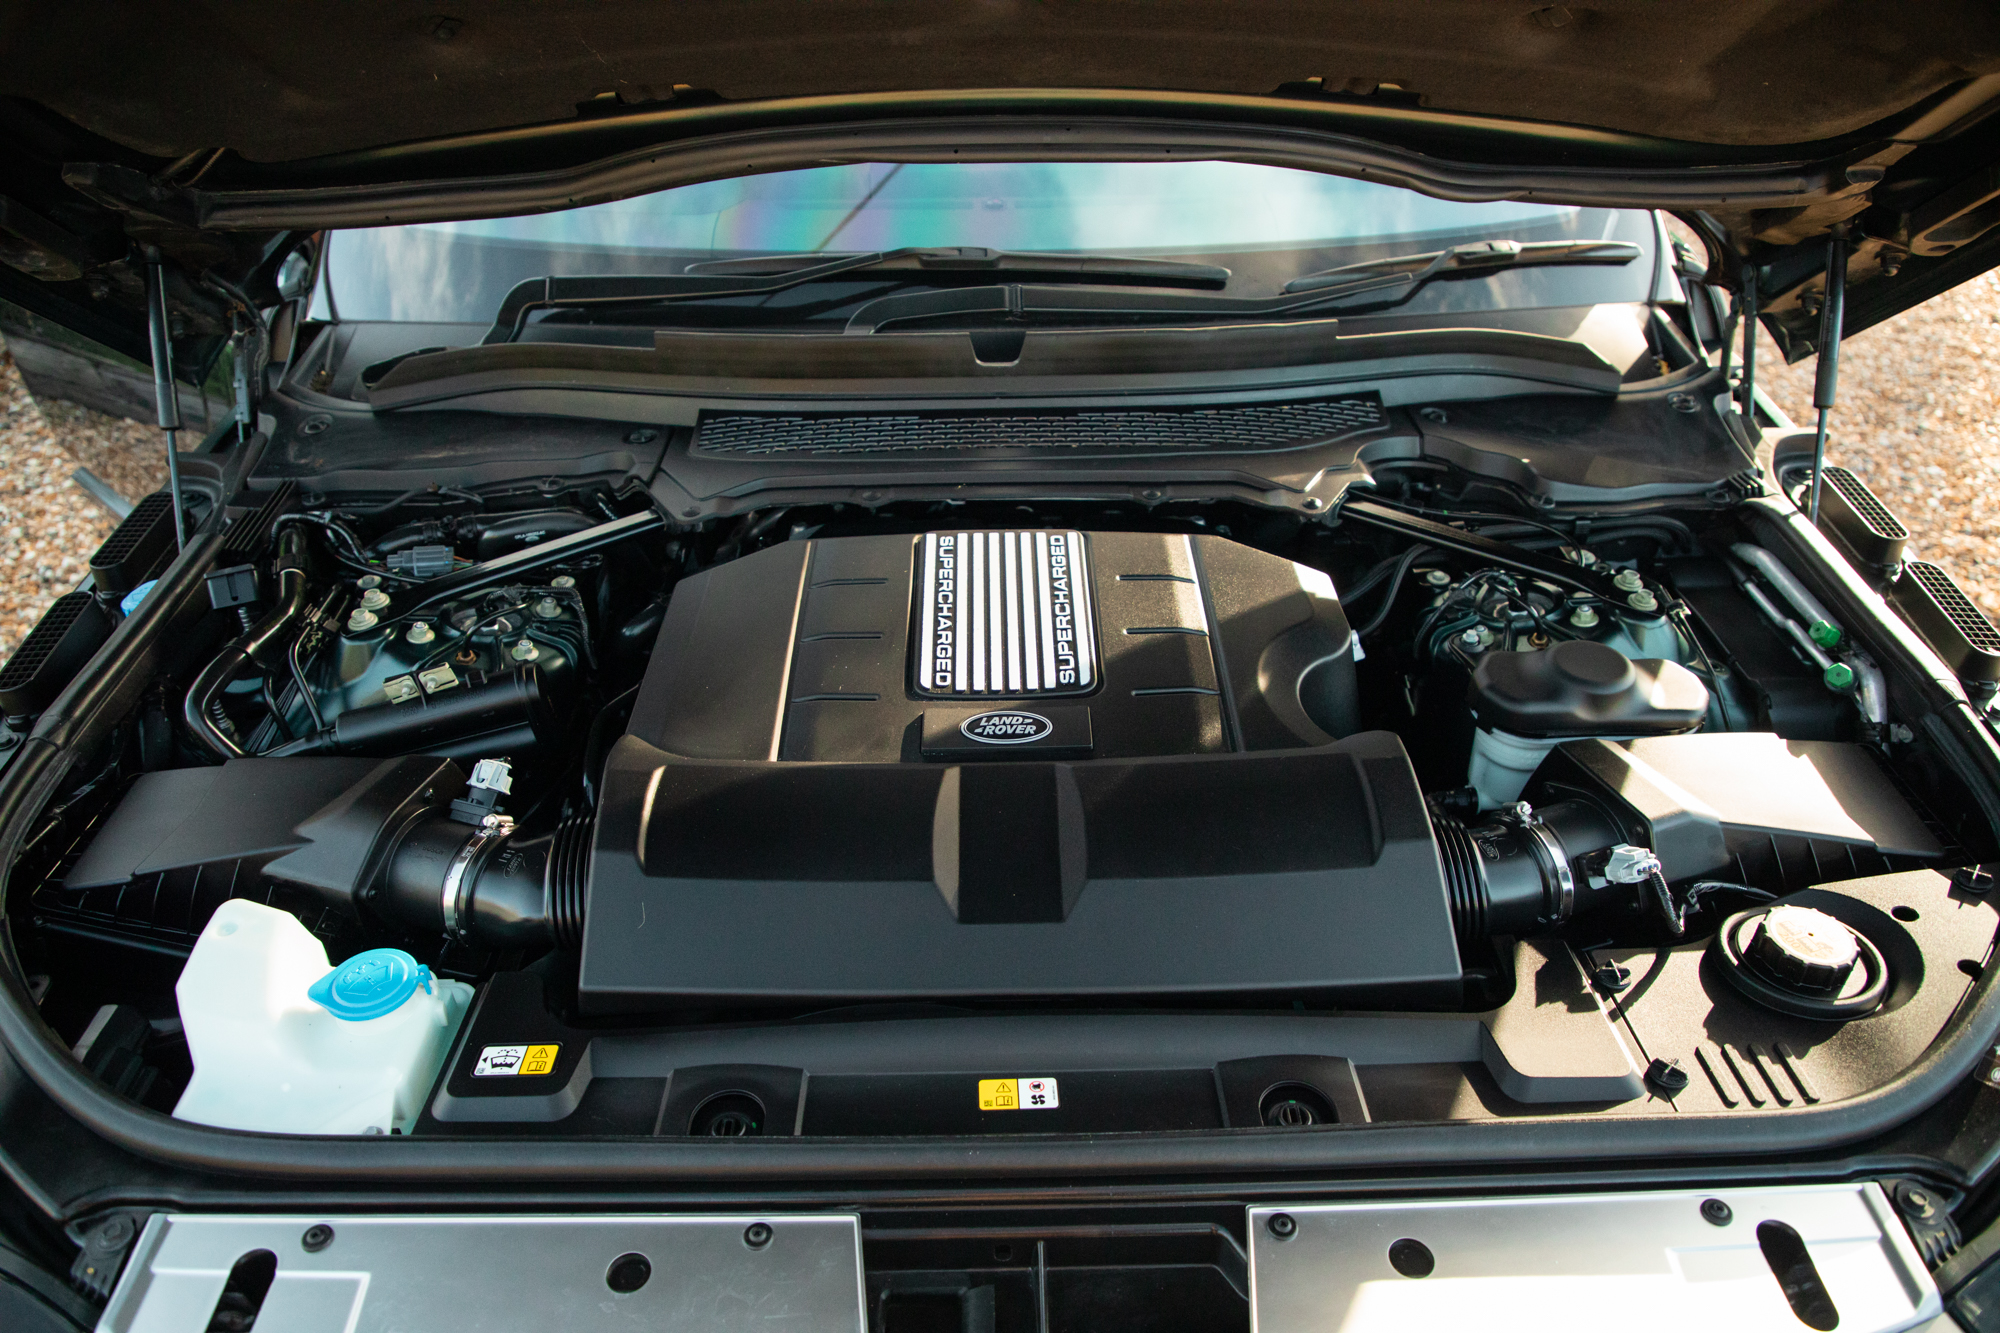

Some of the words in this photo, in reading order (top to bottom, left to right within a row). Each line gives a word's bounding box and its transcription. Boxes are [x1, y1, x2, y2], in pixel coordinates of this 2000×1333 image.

[935, 535, 954, 686] SUPERCHARGED
[1050, 534, 1075, 684] SUPERCHARGED
[980, 716, 1023, 726] LAND
[983, 725, 1037, 735] ROVER
